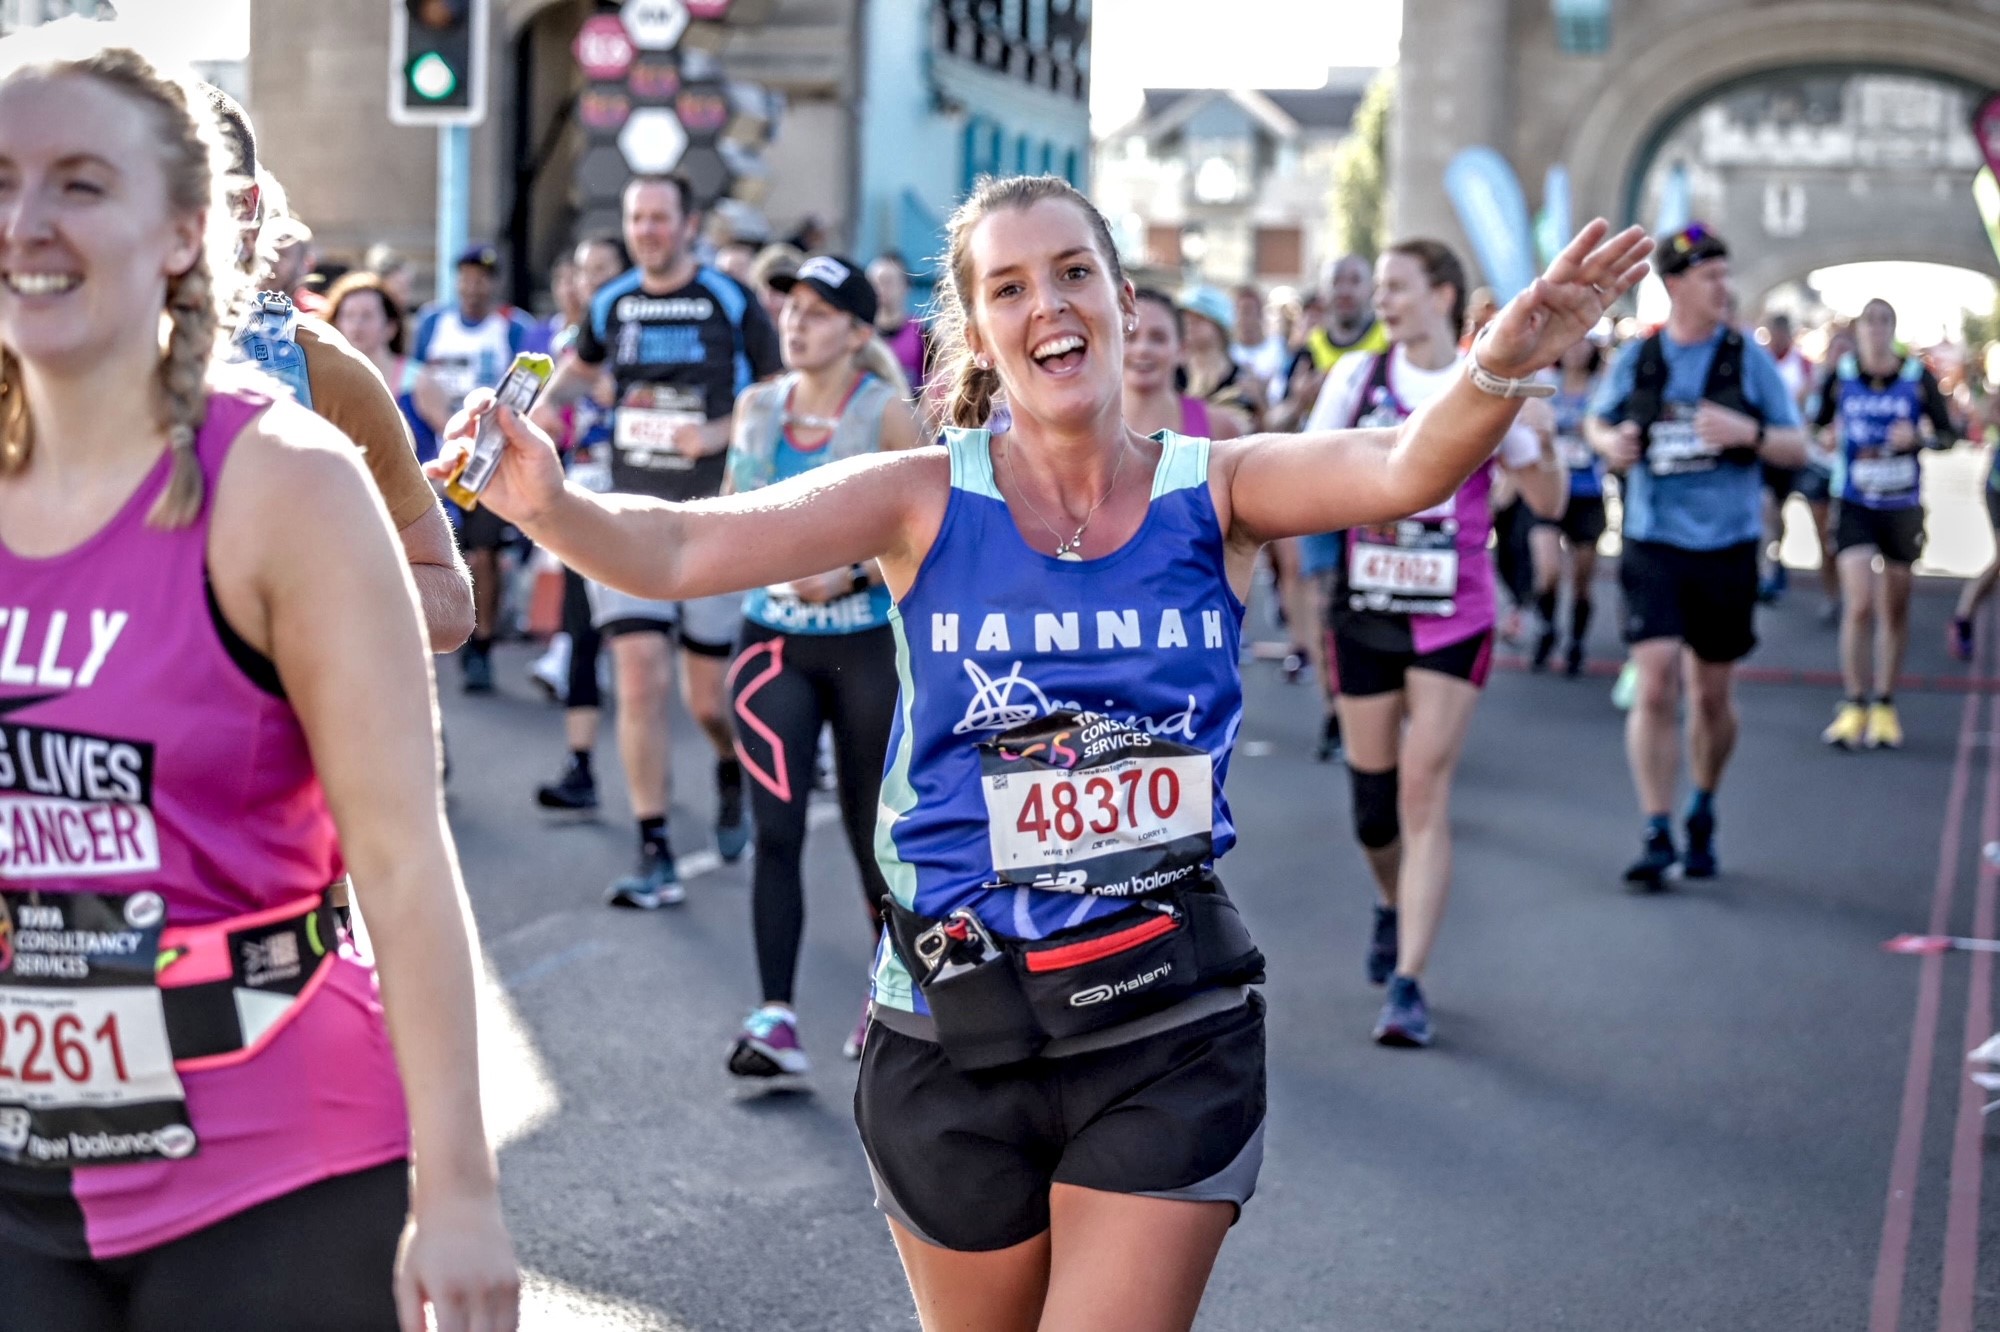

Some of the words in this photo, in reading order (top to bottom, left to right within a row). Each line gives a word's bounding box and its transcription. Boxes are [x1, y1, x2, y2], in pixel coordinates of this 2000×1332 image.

[0, 607, 129, 688] LLY
[931, 608, 1223, 652] HANNAH
[17, 727, 142, 803] LIVES
[1083, 732, 1152, 758] SERVICES
[1016, 766, 1181, 843] 48370
[0, 802, 144, 865] ANCER
[1091, 882, 1129, 896] new
[1131, 864, 1194, 895] balance
[1113, 962, 1172, 996] Kalenji
